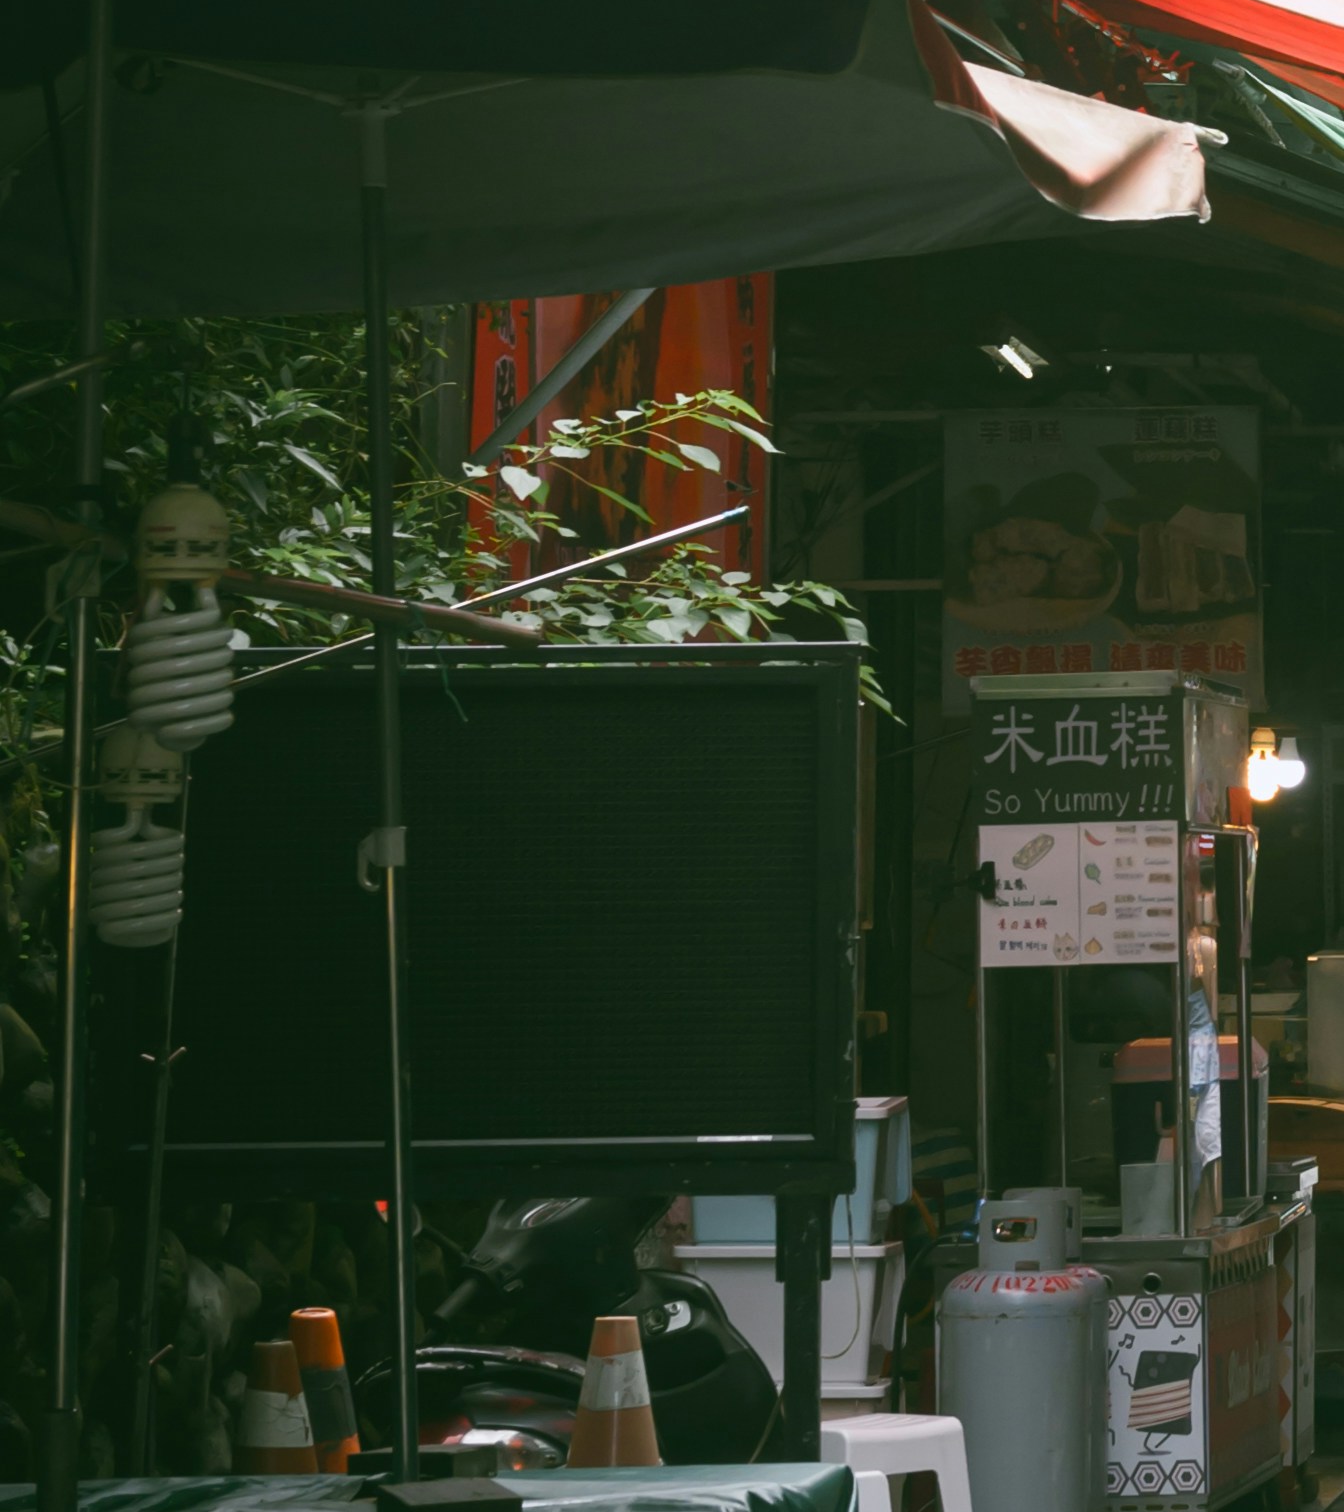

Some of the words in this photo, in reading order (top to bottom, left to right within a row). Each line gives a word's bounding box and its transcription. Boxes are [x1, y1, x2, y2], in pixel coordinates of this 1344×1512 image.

[978, 419, 1065, 444] 芋頭糕
[983, 703, 1174, 774] 米血糕
[984, 788, 1022, 815] So
